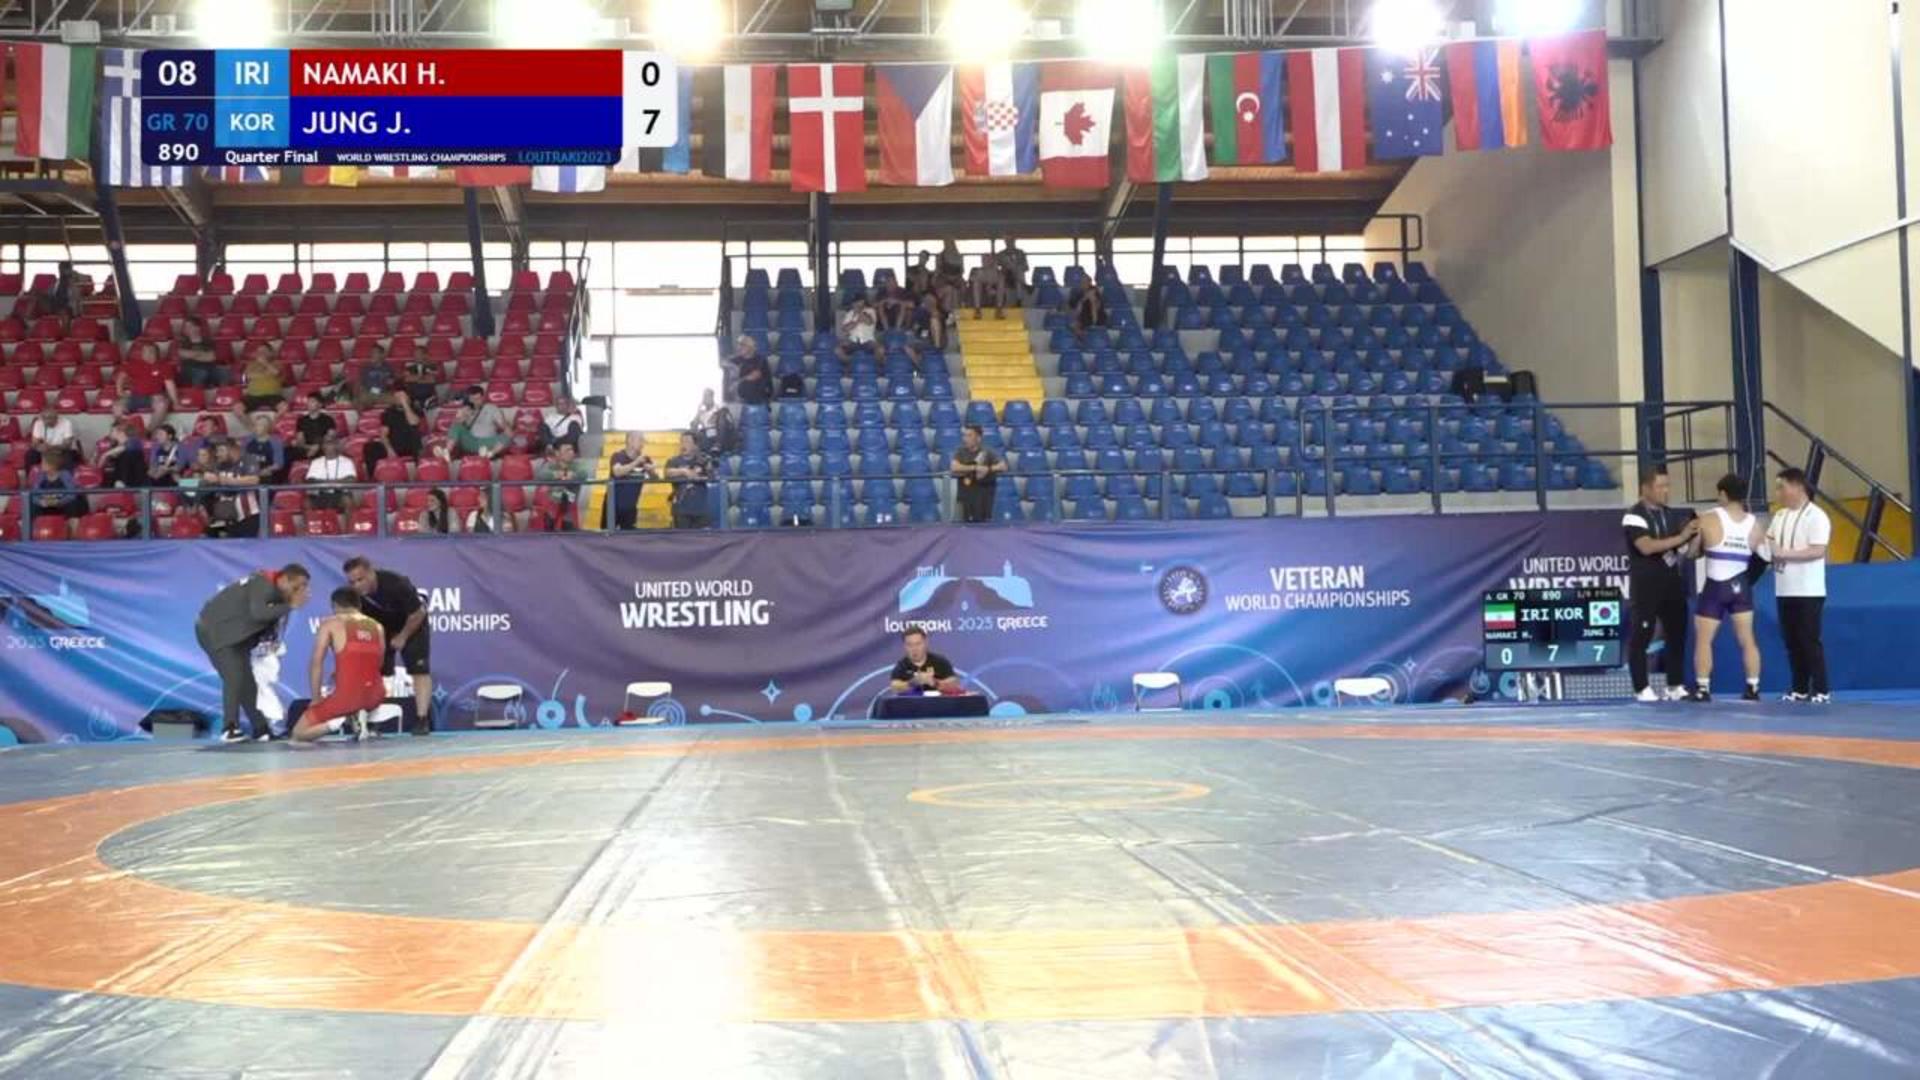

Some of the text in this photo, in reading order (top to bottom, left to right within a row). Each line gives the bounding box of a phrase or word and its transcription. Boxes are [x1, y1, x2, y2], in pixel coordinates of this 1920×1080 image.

[1523, 556, 1576, 574] UNITED
[1270, 566, 1364, 591] VETERAN
[635, 580, 753, 599] UNITED WORLD
[1542, 590, 1561, 600] 890
[1225, 589, 1411, 611] WORLD CHAMPIONSHIPS
[620, 599, 770, 628] WRESTLING
[1521, 608, 1549, 621] IRI
[1554, 607, 1584, 620] KOR
[997, 615, 1048, 632] GREECE
[1501, 647, 1513, 665] 0
[1547, 644, 1559, 662] 7
[1593, 644, 1605, 662] 7
